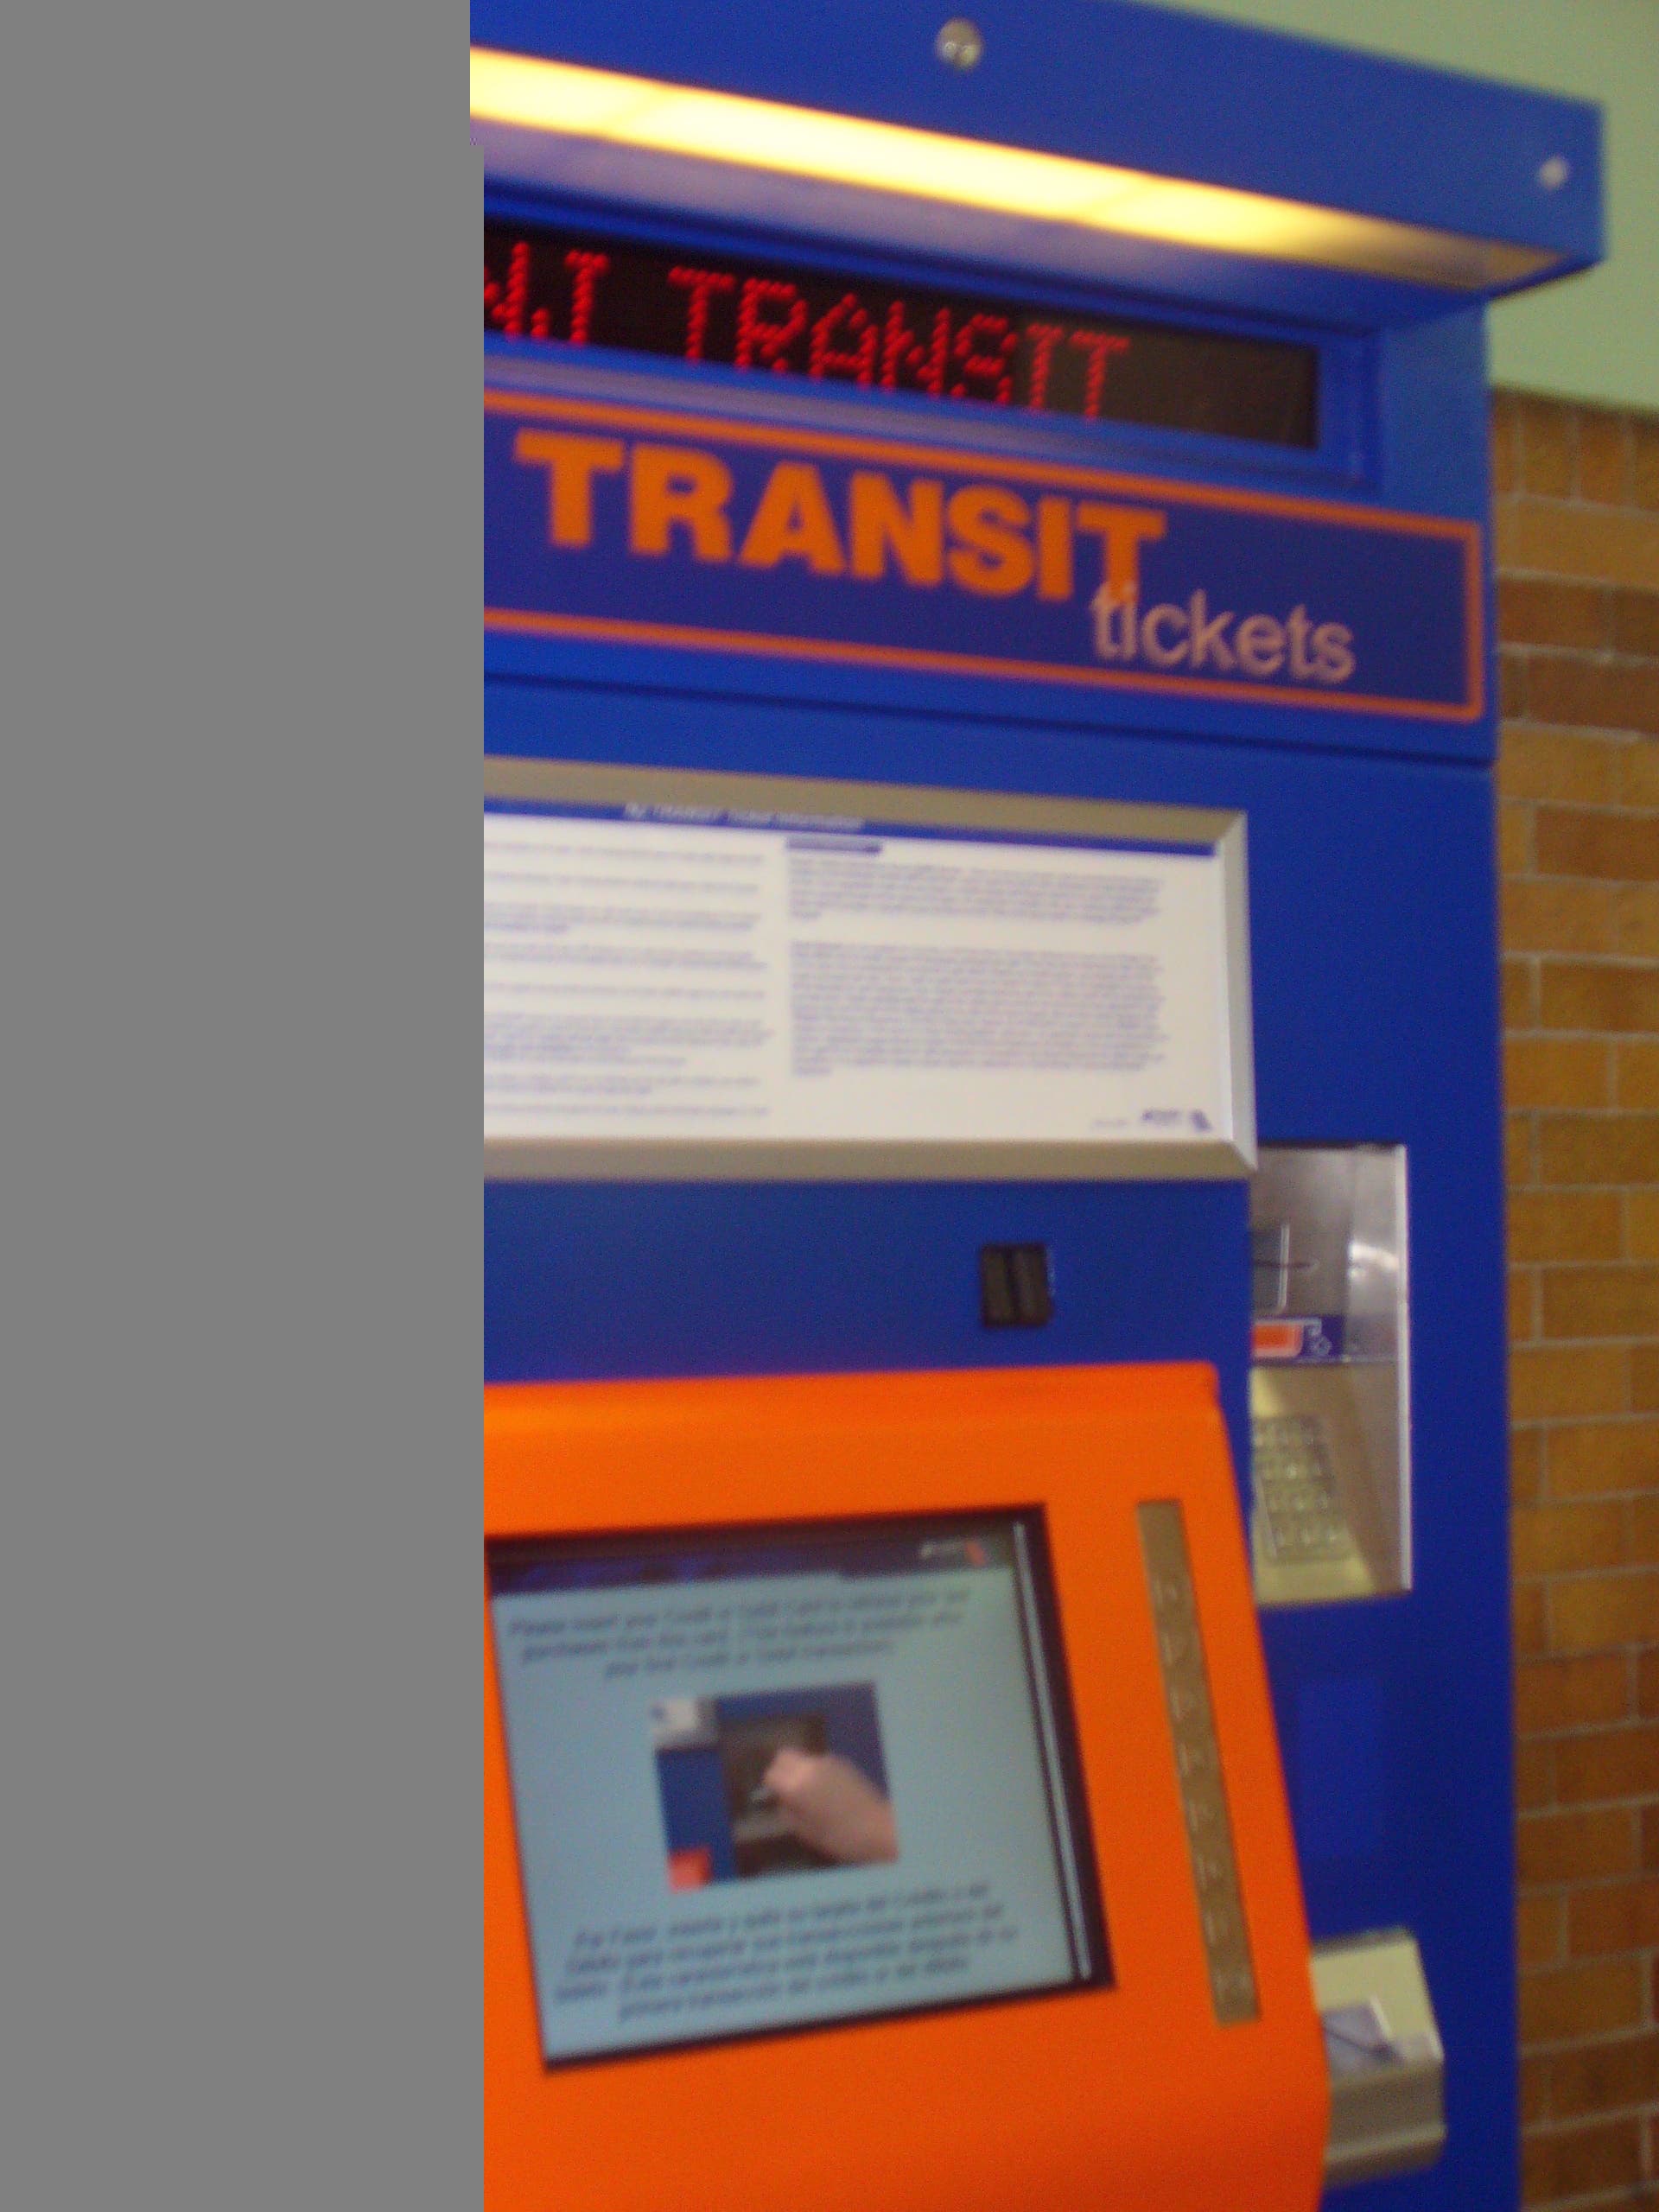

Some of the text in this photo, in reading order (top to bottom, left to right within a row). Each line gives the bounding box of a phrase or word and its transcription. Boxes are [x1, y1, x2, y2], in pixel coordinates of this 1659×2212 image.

[667, 263, 1131, 421] TRANSIT
[513, 427, 1167, 605] TRANSIT
[1089, 586, 1357, 687] tickets
